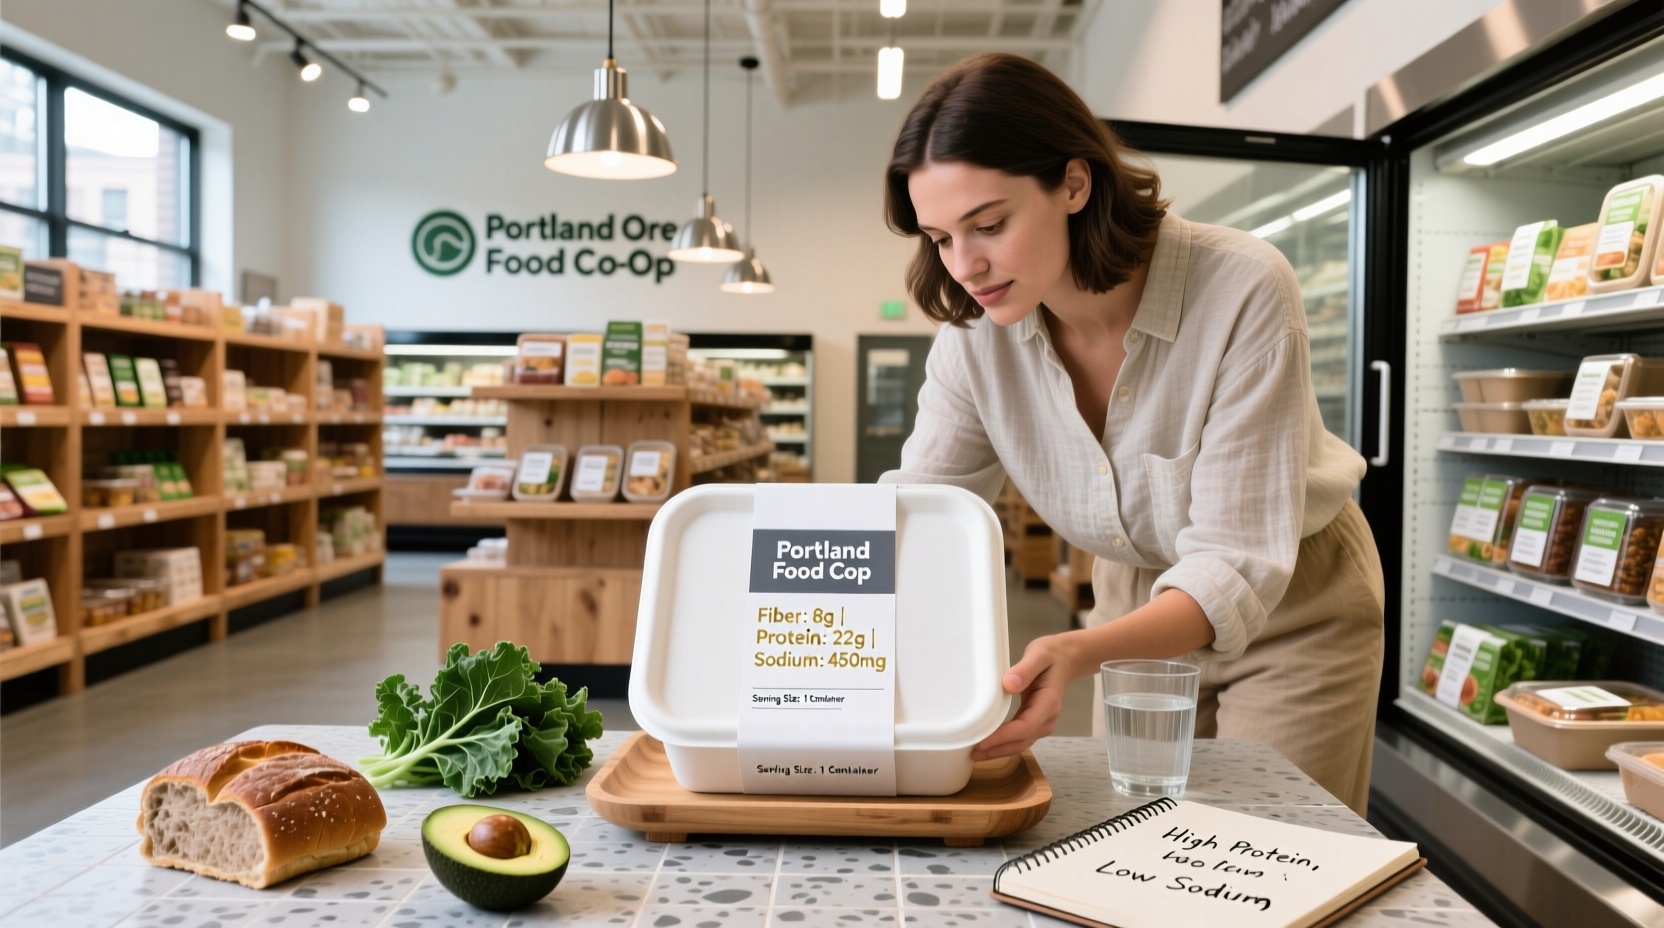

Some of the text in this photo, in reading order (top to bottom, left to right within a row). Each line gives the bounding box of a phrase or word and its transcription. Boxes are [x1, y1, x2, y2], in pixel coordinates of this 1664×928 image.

[486, 212, 678, 241] Portland Ore
[486, 248, 676, 283] Food Co-Op
[776, 540, 870, 560] Portland
[773, 562, 871, 585] Food Cop
[757, 606, 808, 624] Fiber:
[812, 608, 834, 628] 8g
[756, 628, 827, 646] Protein:
[832, 629, 866, 650] 22g
[754, 652, 887, 673] Sodium: 450mg
[819, 765, 825, 775] 1
[1162, 826, 1218, 851] High
[1229, 840, 1320, 872] Protein,
[1095, 860, 1157, 882] Low
